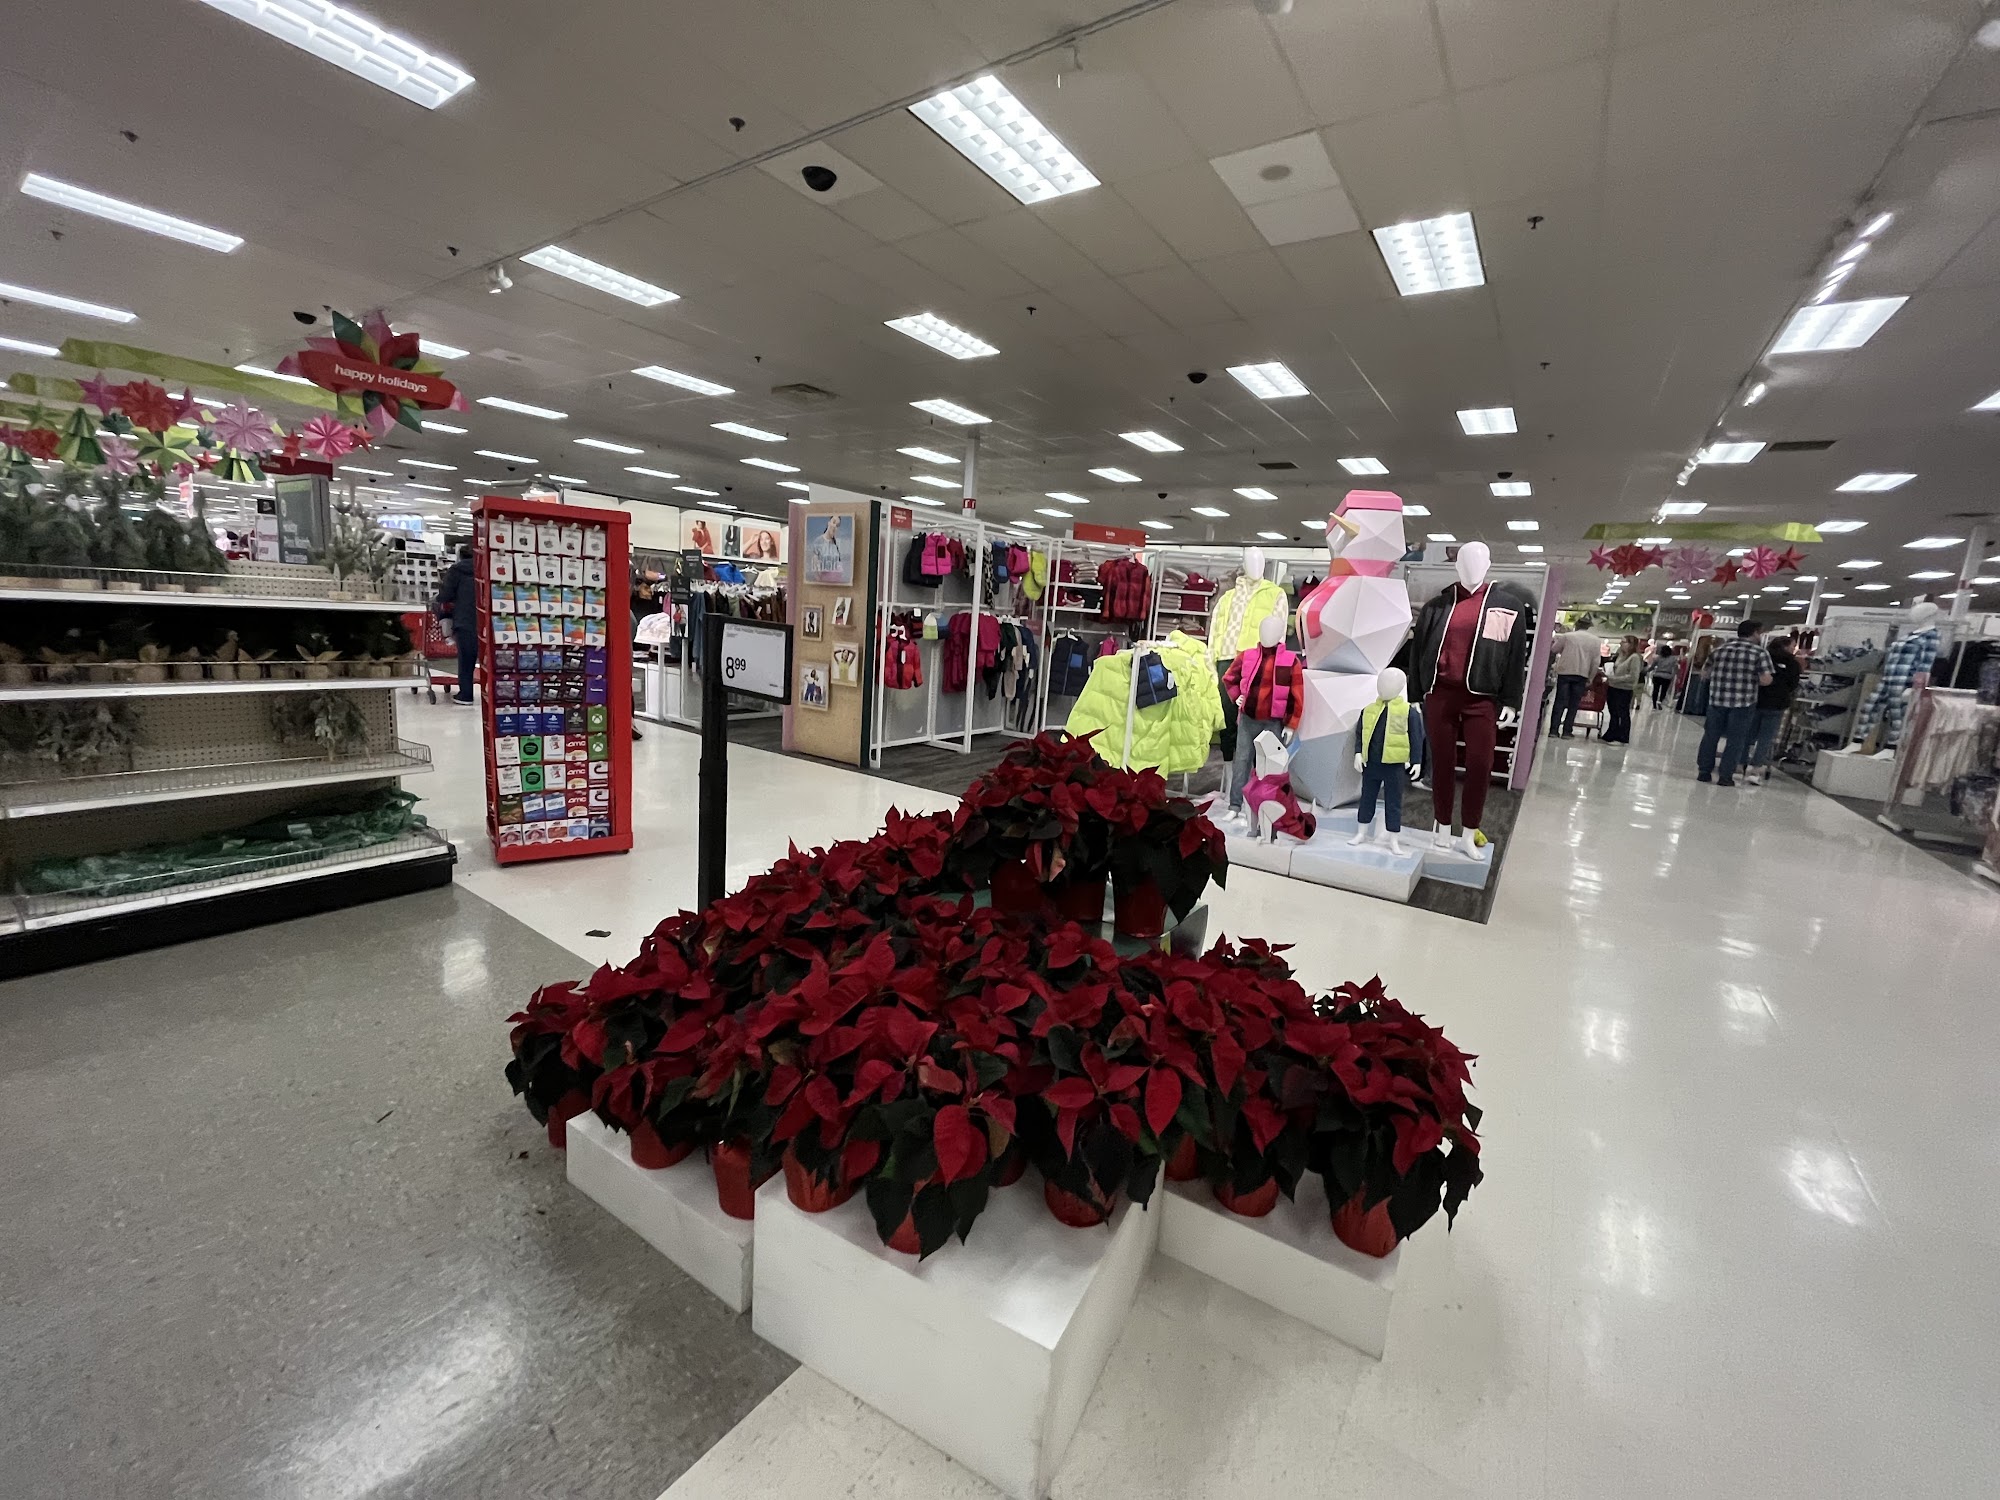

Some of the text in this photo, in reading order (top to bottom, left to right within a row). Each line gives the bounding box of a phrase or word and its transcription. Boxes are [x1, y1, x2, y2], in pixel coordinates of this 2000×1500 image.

[335, 364, 428, 393] happy holidays
[567, 768, 587, 776] amc
[568, 796, 588, 804] amc
